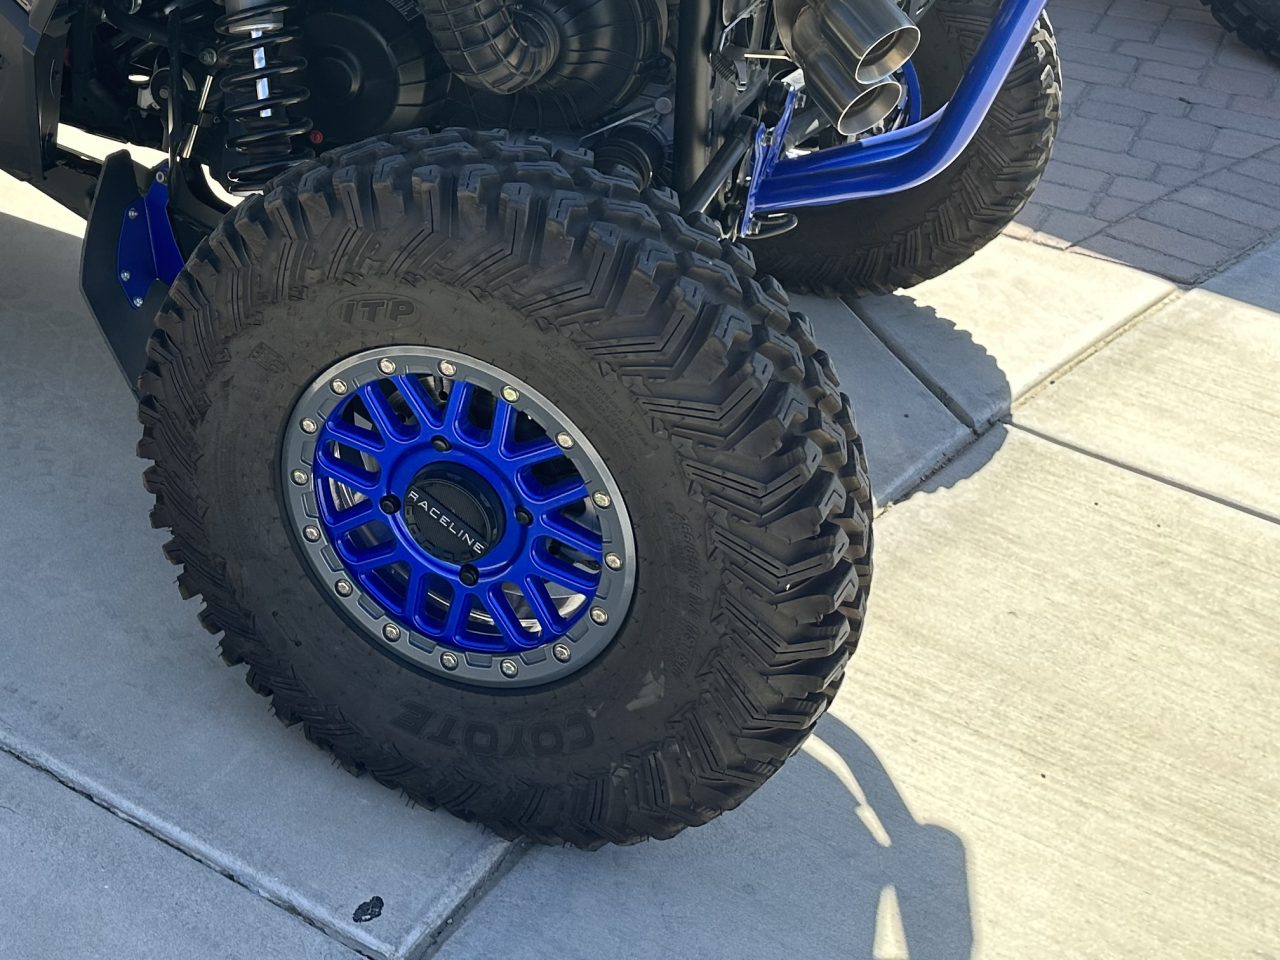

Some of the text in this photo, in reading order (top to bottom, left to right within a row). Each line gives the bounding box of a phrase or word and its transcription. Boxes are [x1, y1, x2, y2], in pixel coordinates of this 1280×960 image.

[340, 296, 415, 325] ITP
[407, 490, 485, 554] RACELINE
[388, 699, 595, 758] COYOTE
